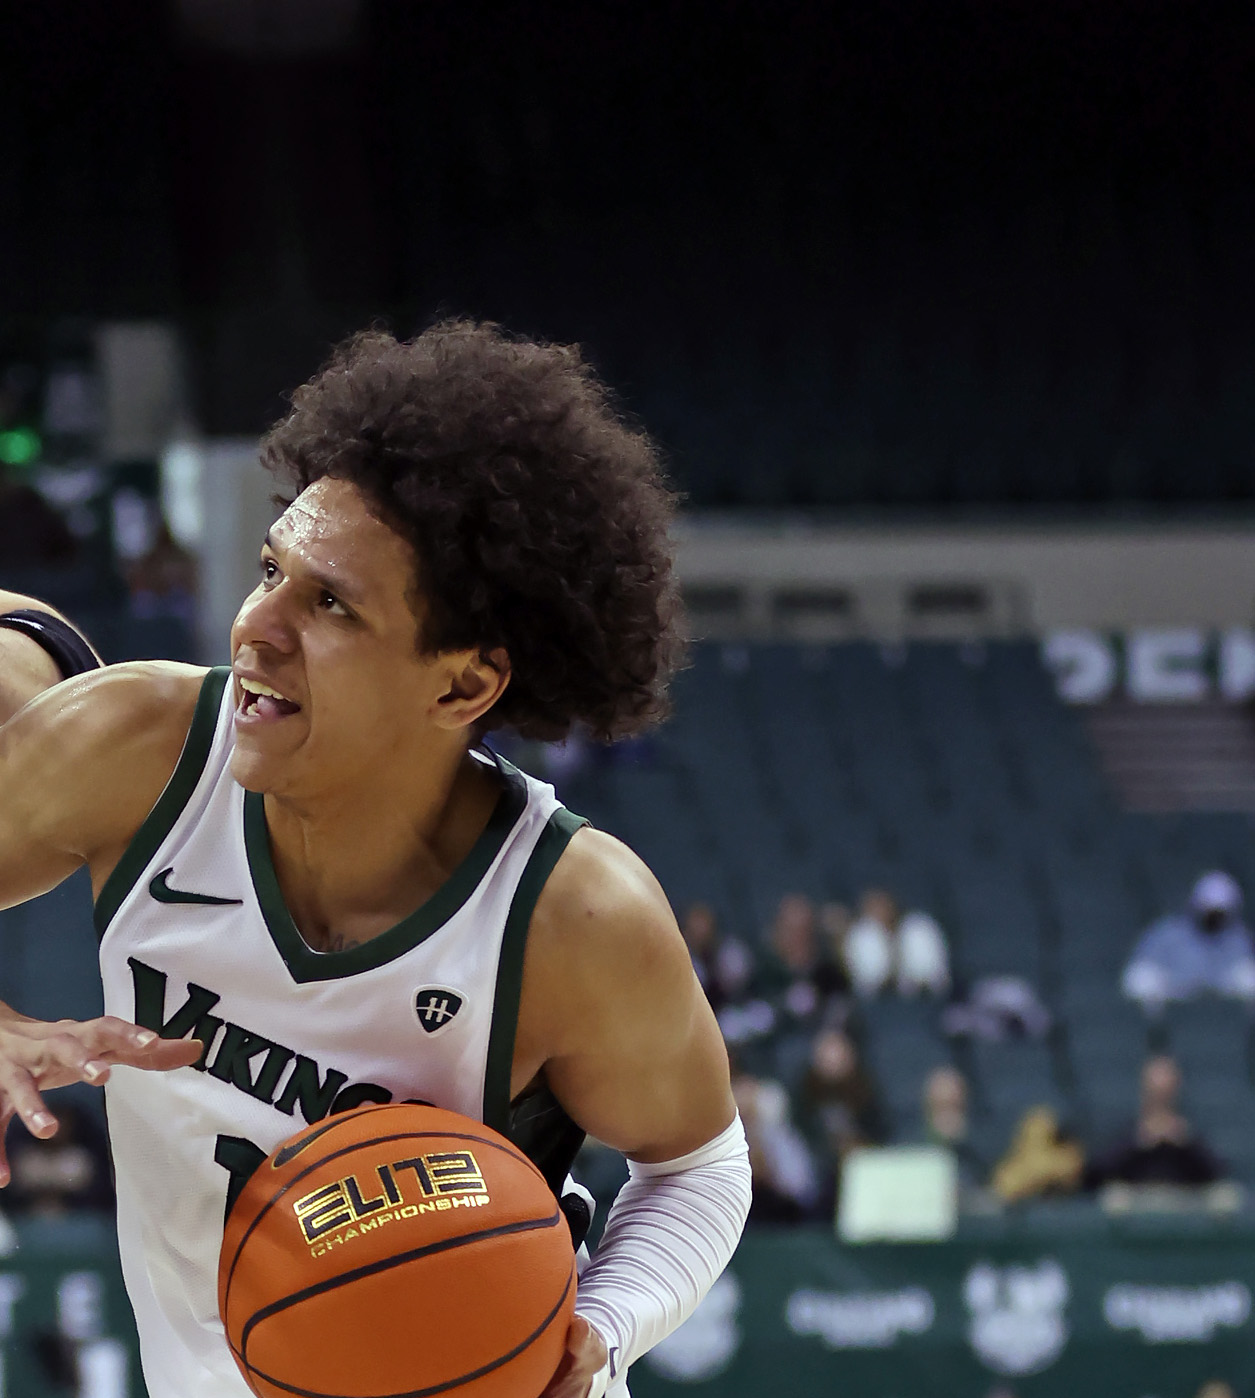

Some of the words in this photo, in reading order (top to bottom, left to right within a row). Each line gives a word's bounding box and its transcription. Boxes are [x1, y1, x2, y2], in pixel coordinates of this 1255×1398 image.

[128, 956, 437, 1125] VIKIN
[293, 1150, 487, 1244] ELITE
[310, 1195, 491, 1258] CHAMPIONSHIP
